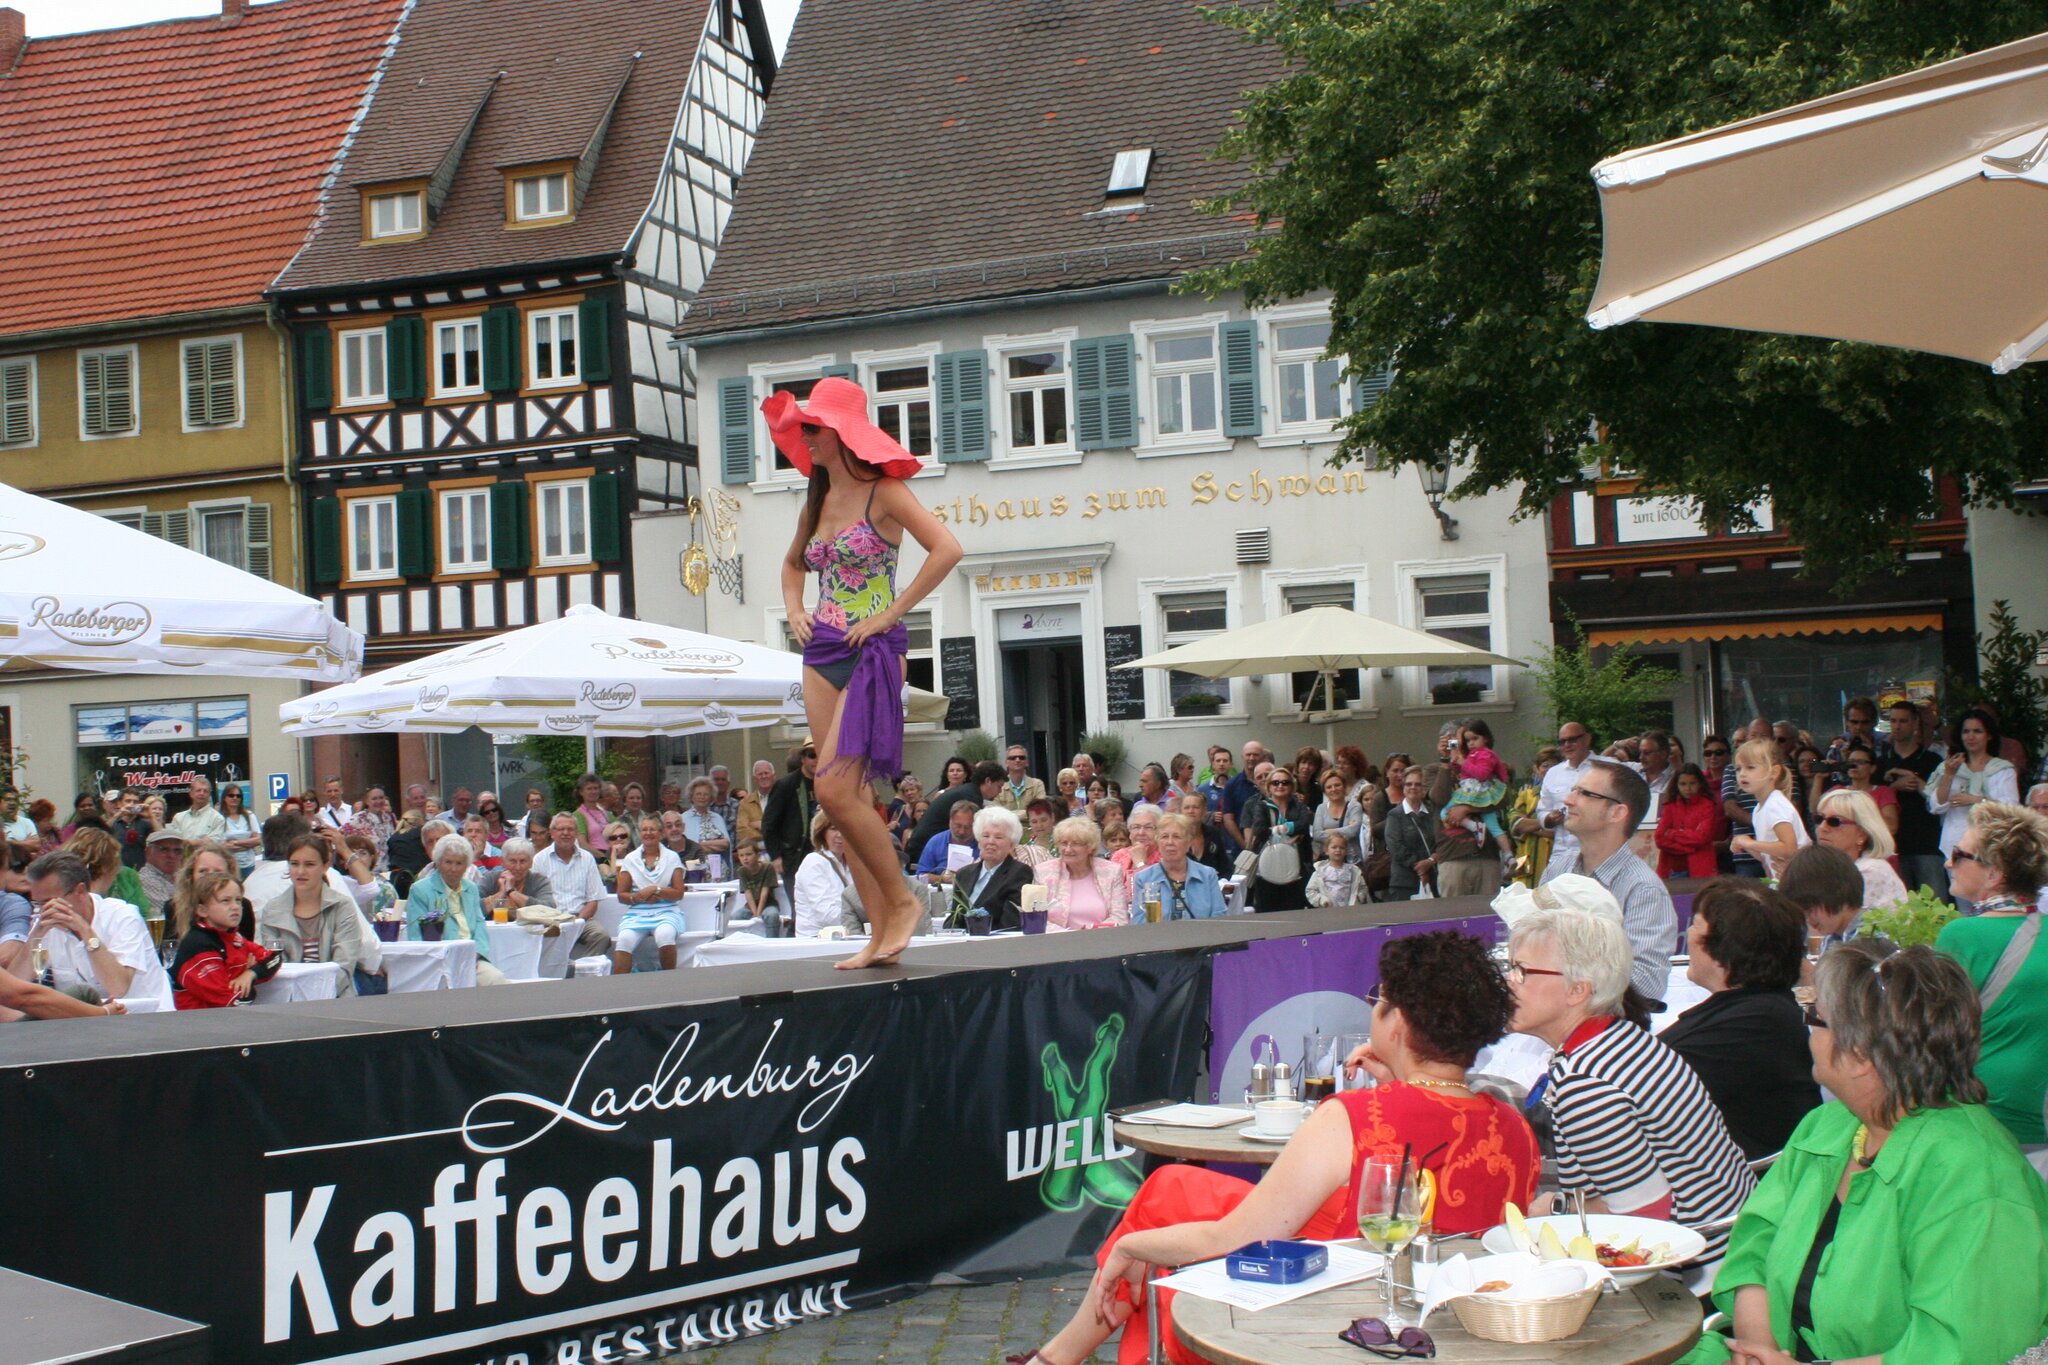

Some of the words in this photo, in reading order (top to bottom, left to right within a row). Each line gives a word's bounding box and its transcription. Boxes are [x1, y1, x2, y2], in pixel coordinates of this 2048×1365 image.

[931, 494, 1069, 527] sthaus
[1081, 486, 1168, 519] zum
[1191, 468, 1368, 506] Schwan
[1657, 507, 1690, 522] 1600
[27, 595, 150, 641] Radeberger
[591, 643, 743, 666] Radeberger
[581, 681, 635, 708] Radeberger
[107, 752, 220, 767] Textilpflege
[272, 776, 285, 797] P
[462, 1018, 874, 1154] Ladenburg
[263, 1136, 868, 1344] Kaffeehaus
[558, 1279, 851, 1365] RESTAURANT
